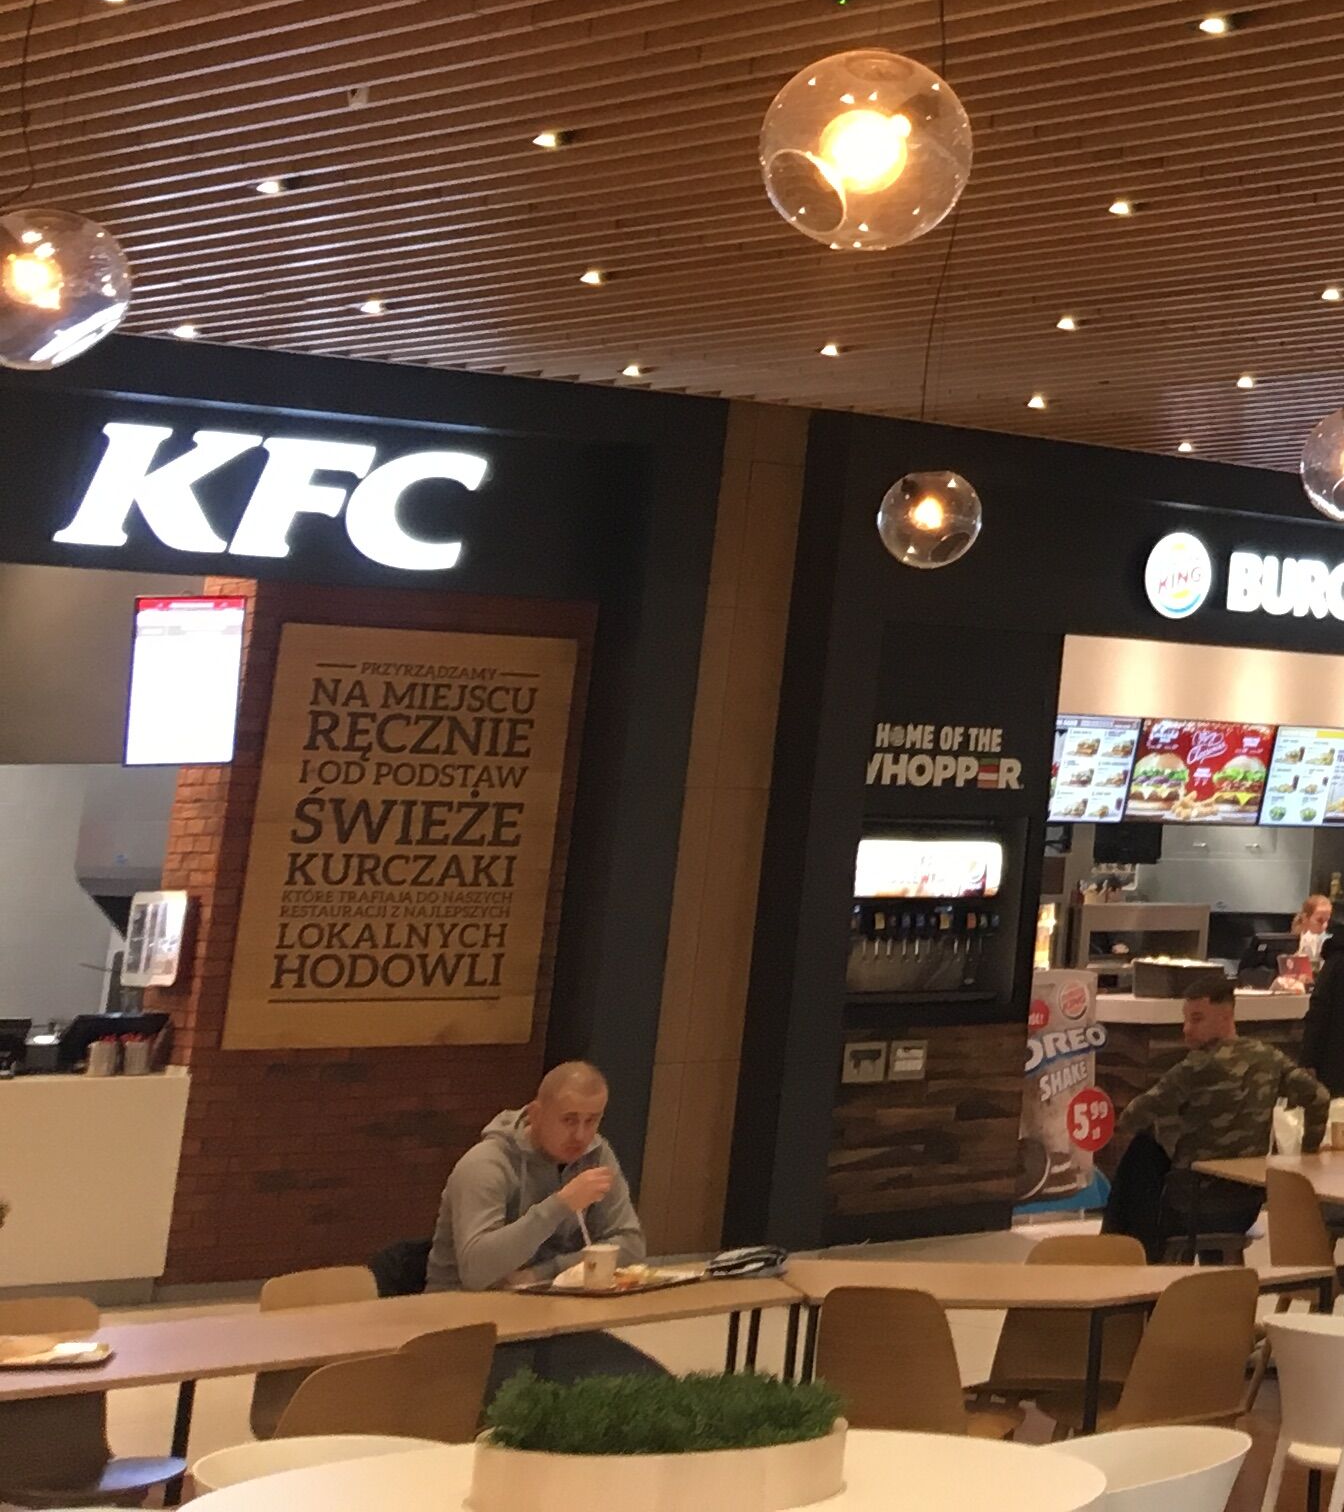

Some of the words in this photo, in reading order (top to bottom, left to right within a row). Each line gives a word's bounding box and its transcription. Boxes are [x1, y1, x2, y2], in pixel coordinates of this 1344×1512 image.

[53, 422, 488, 571] KFC
[309, 677, 369, 708] NA
[380, 681, 538, 714] MIEJSCU
[303, 710, 536, 761] RĘCZNIE
[875, 722, 935, 750] HOME
[939, 725, 965, 751] OF
[968, 727, 1003, 752] THE
[299, 759, 311, 784] I
[317, 760, 366, 785] OD
[373, 762, 529, 788] PODSTAW
[290, 787, 525, 847] ŚWIEŻE
[284, 852, 517, 887] KURCZAKI
[403, 905, 512, 918] NAJLEPSZYCH
[416, 891, 439, 904] DO
[442, 891, 513, 904] NASZYCH
[275, 922, 508, 949] LOKALNYCH
[270, 953, 505, 988] HODOWLI
[1040, 1061, 1088, 1102] SHAKE
